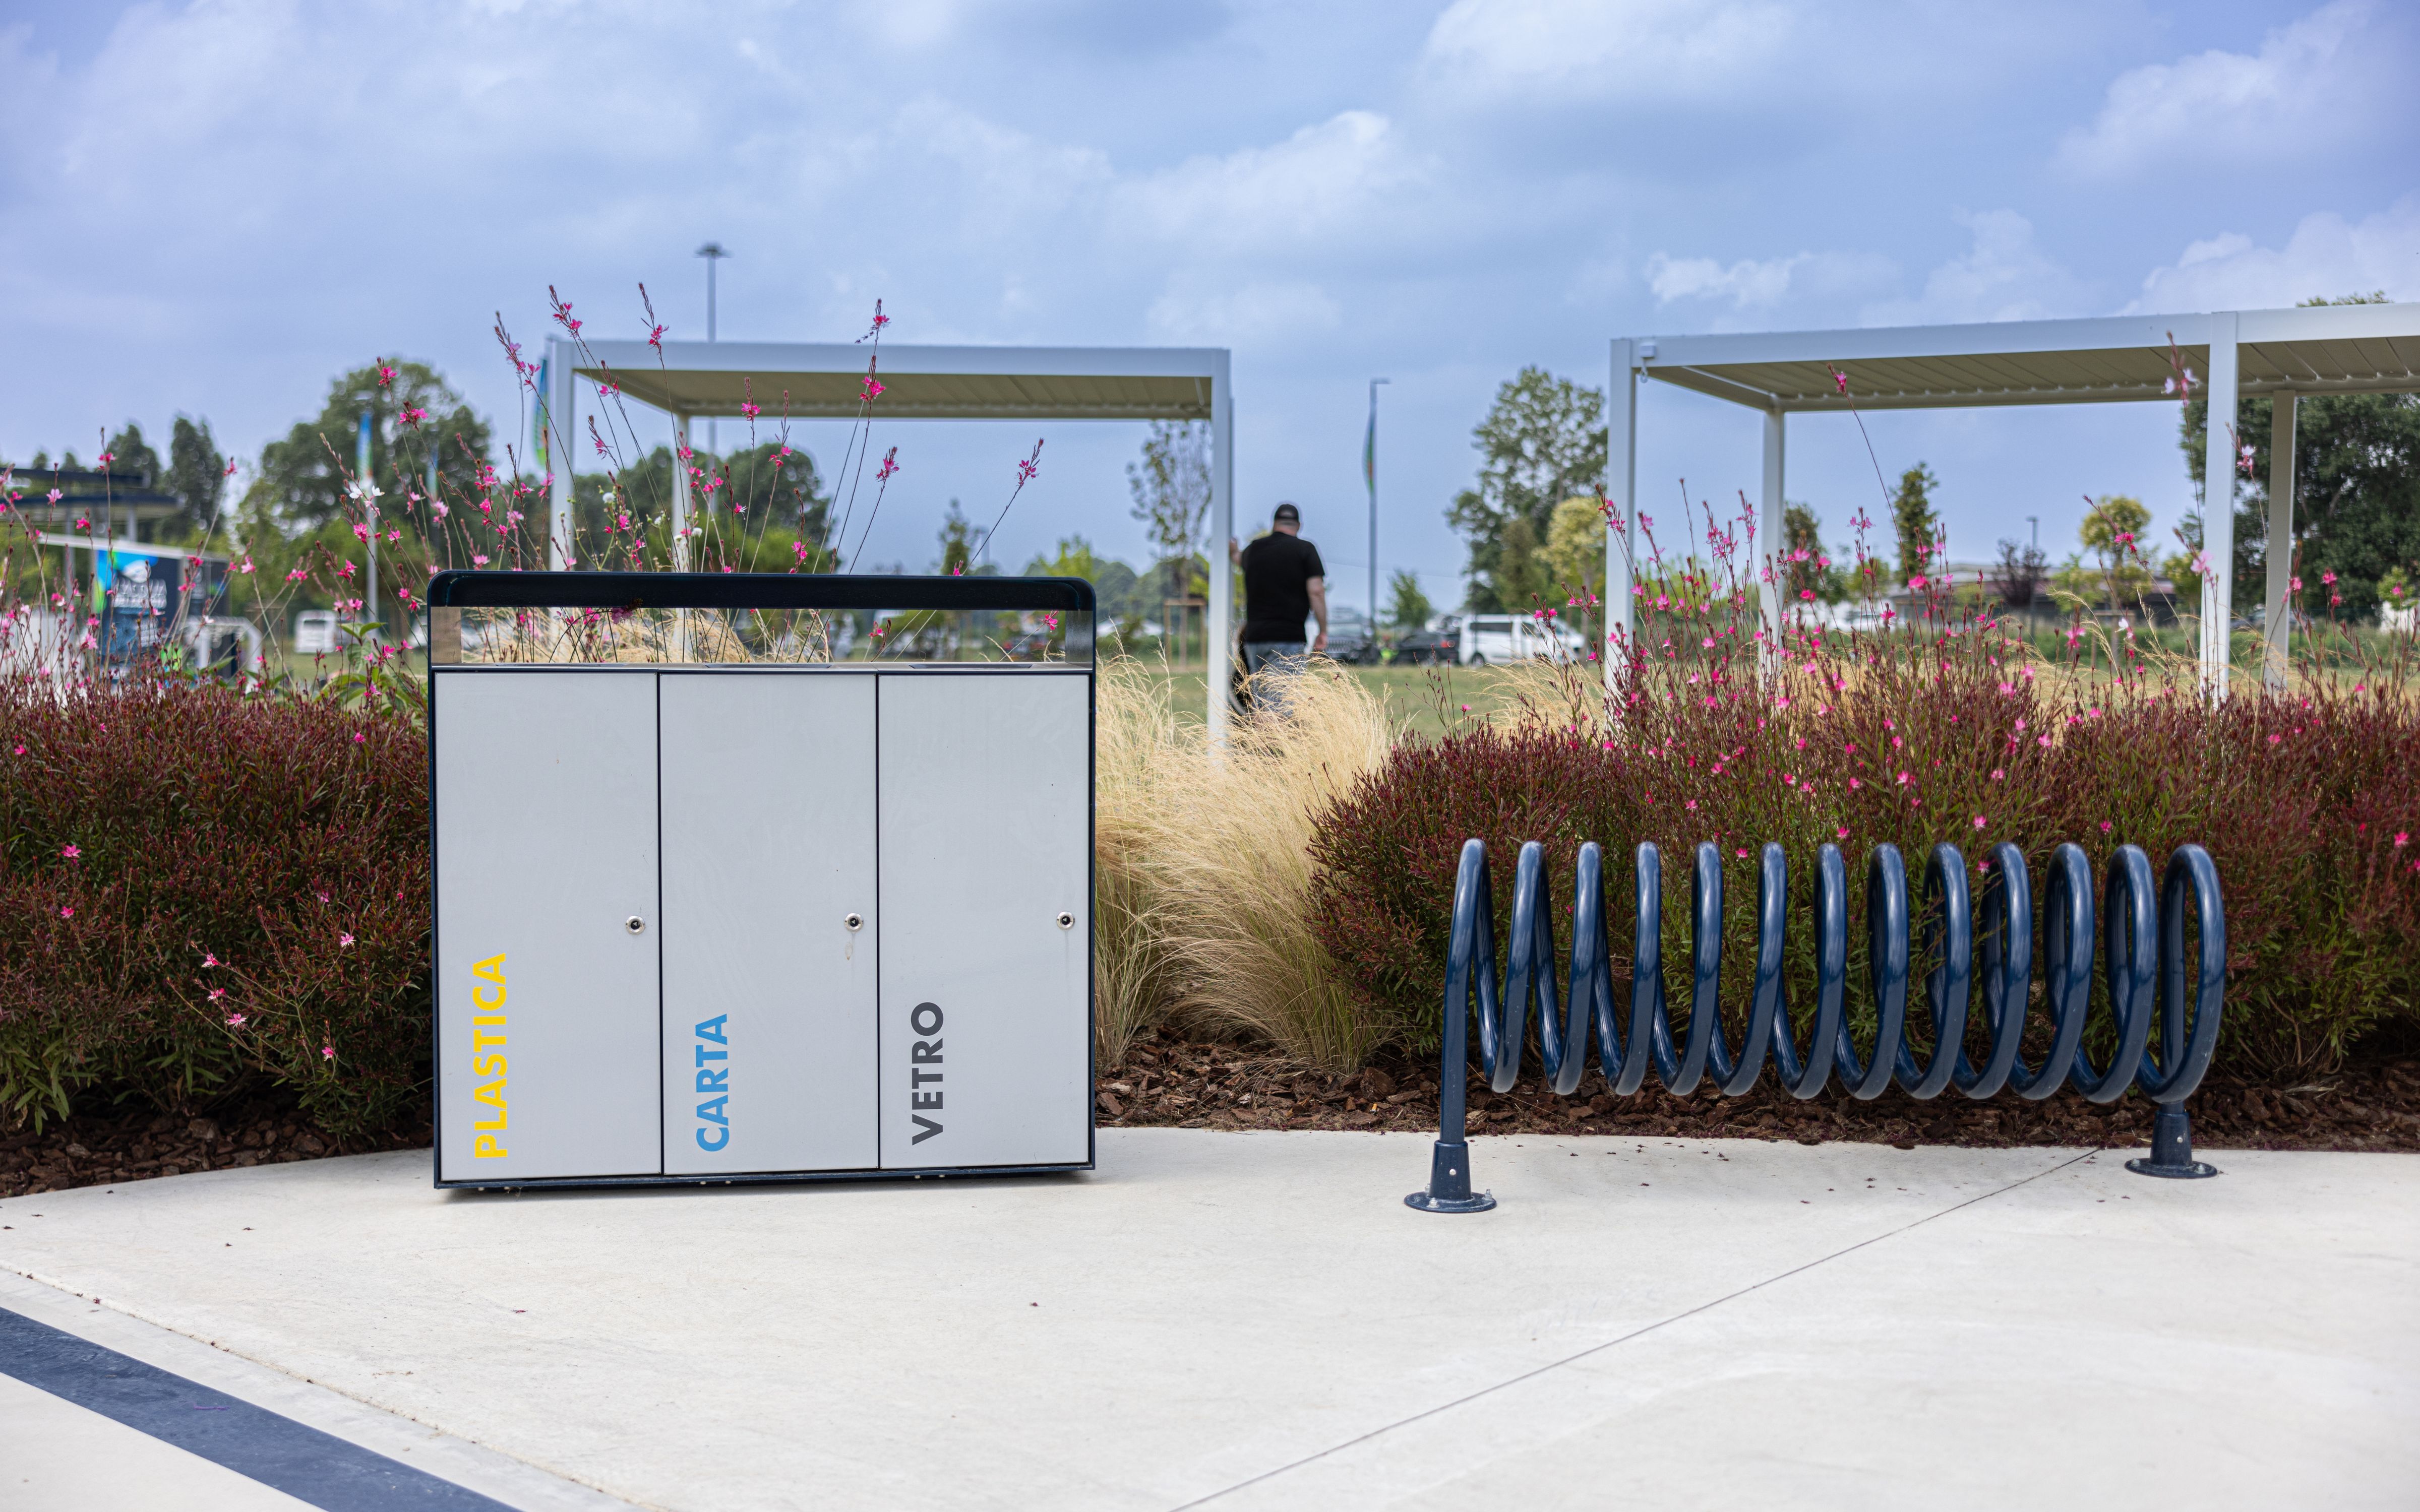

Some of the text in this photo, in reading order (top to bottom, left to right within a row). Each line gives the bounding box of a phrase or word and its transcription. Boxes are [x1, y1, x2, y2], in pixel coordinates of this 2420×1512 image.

[472, 953, 508, 1158] PLASTICA
[695, 1014, 730, 1152] CARTA
[911, 1002, 944, 1145] VETRO
